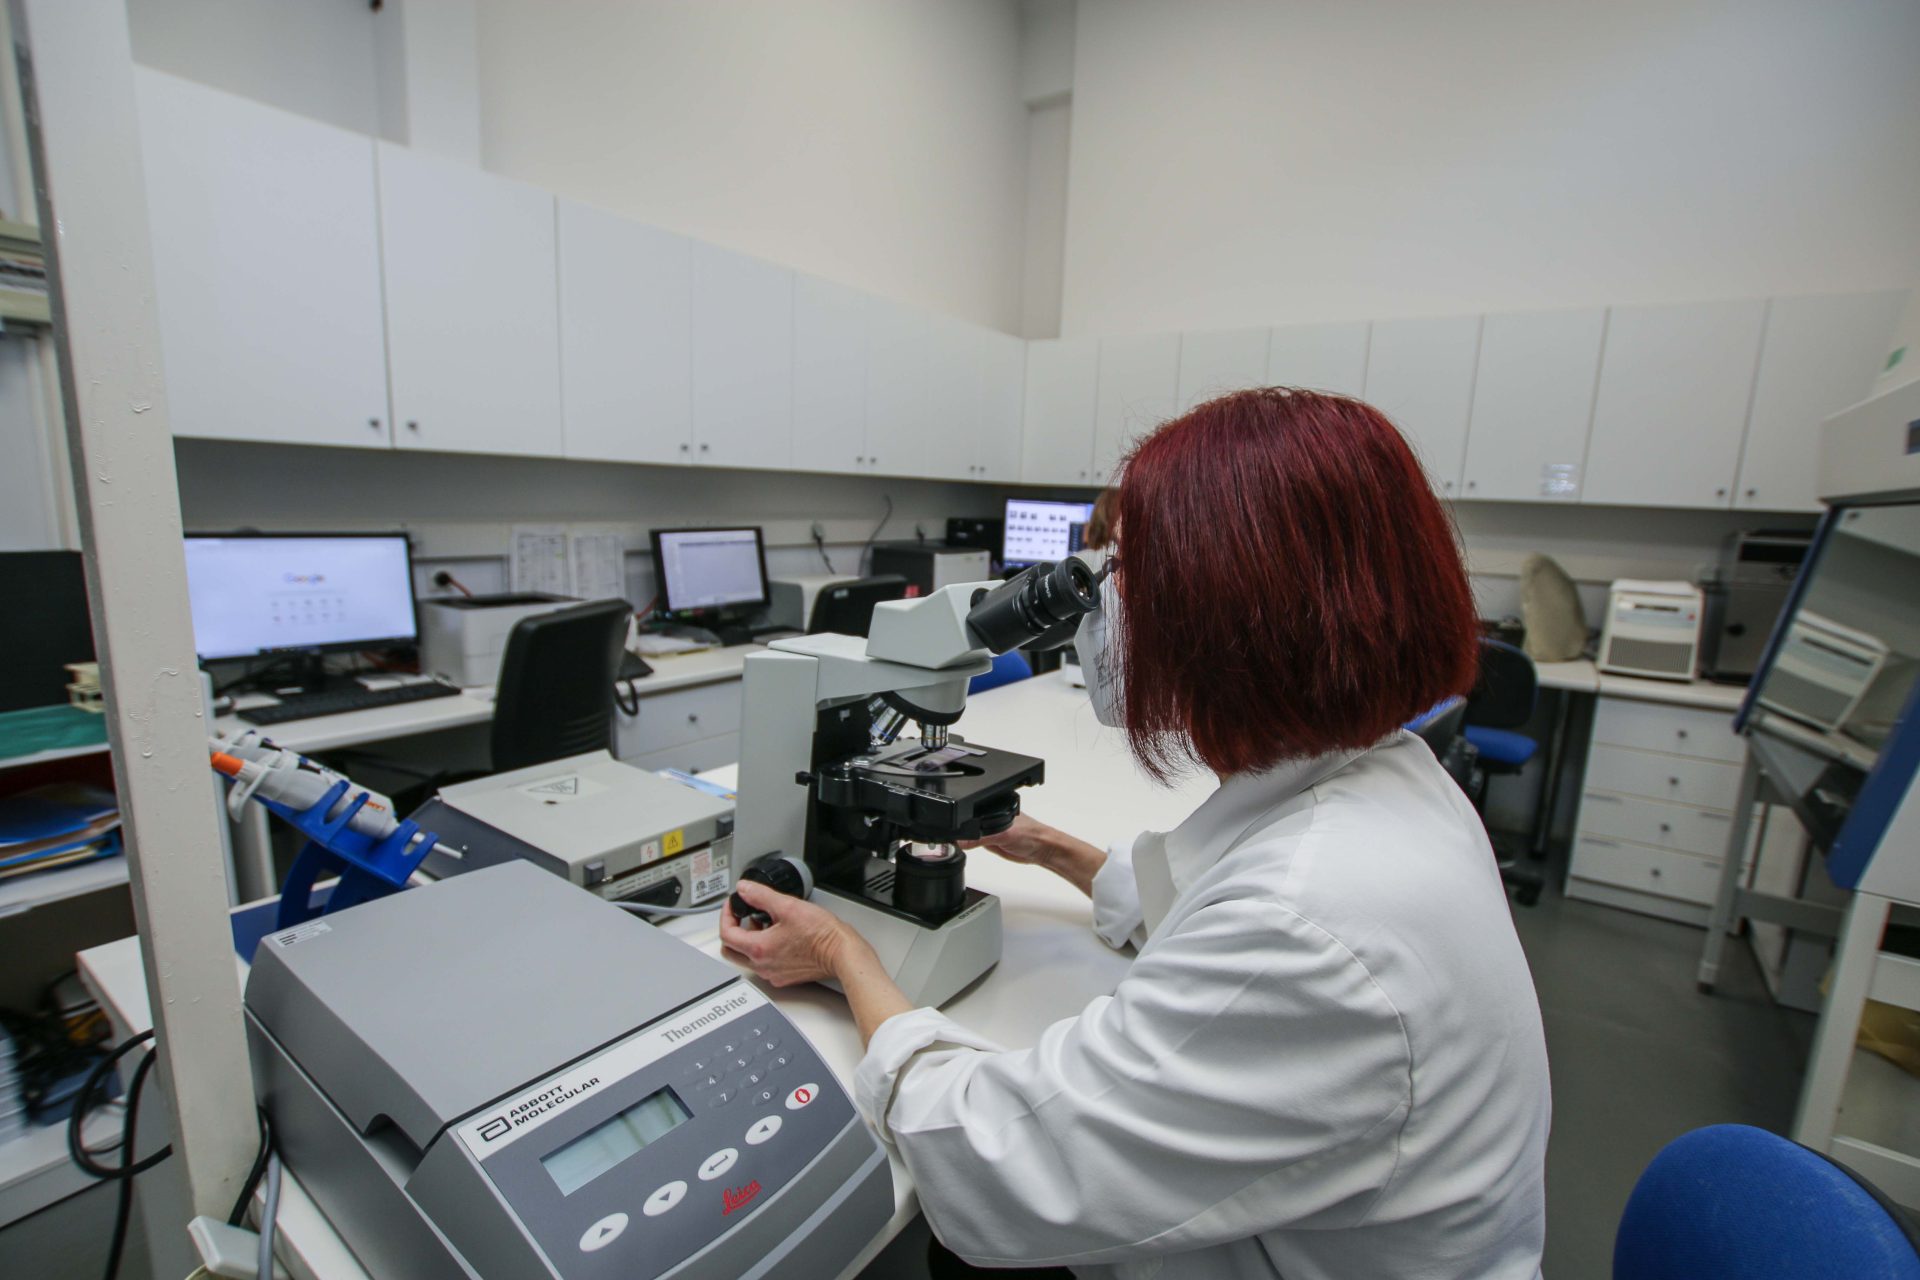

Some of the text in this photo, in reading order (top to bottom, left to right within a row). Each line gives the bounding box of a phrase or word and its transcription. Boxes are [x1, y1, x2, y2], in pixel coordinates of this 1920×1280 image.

[510, 1085, 564, 1118] ABBOTT
[514, 1077, 600, 1126] MOLECULAR
[722, 1179, 762, 1217] Leica
